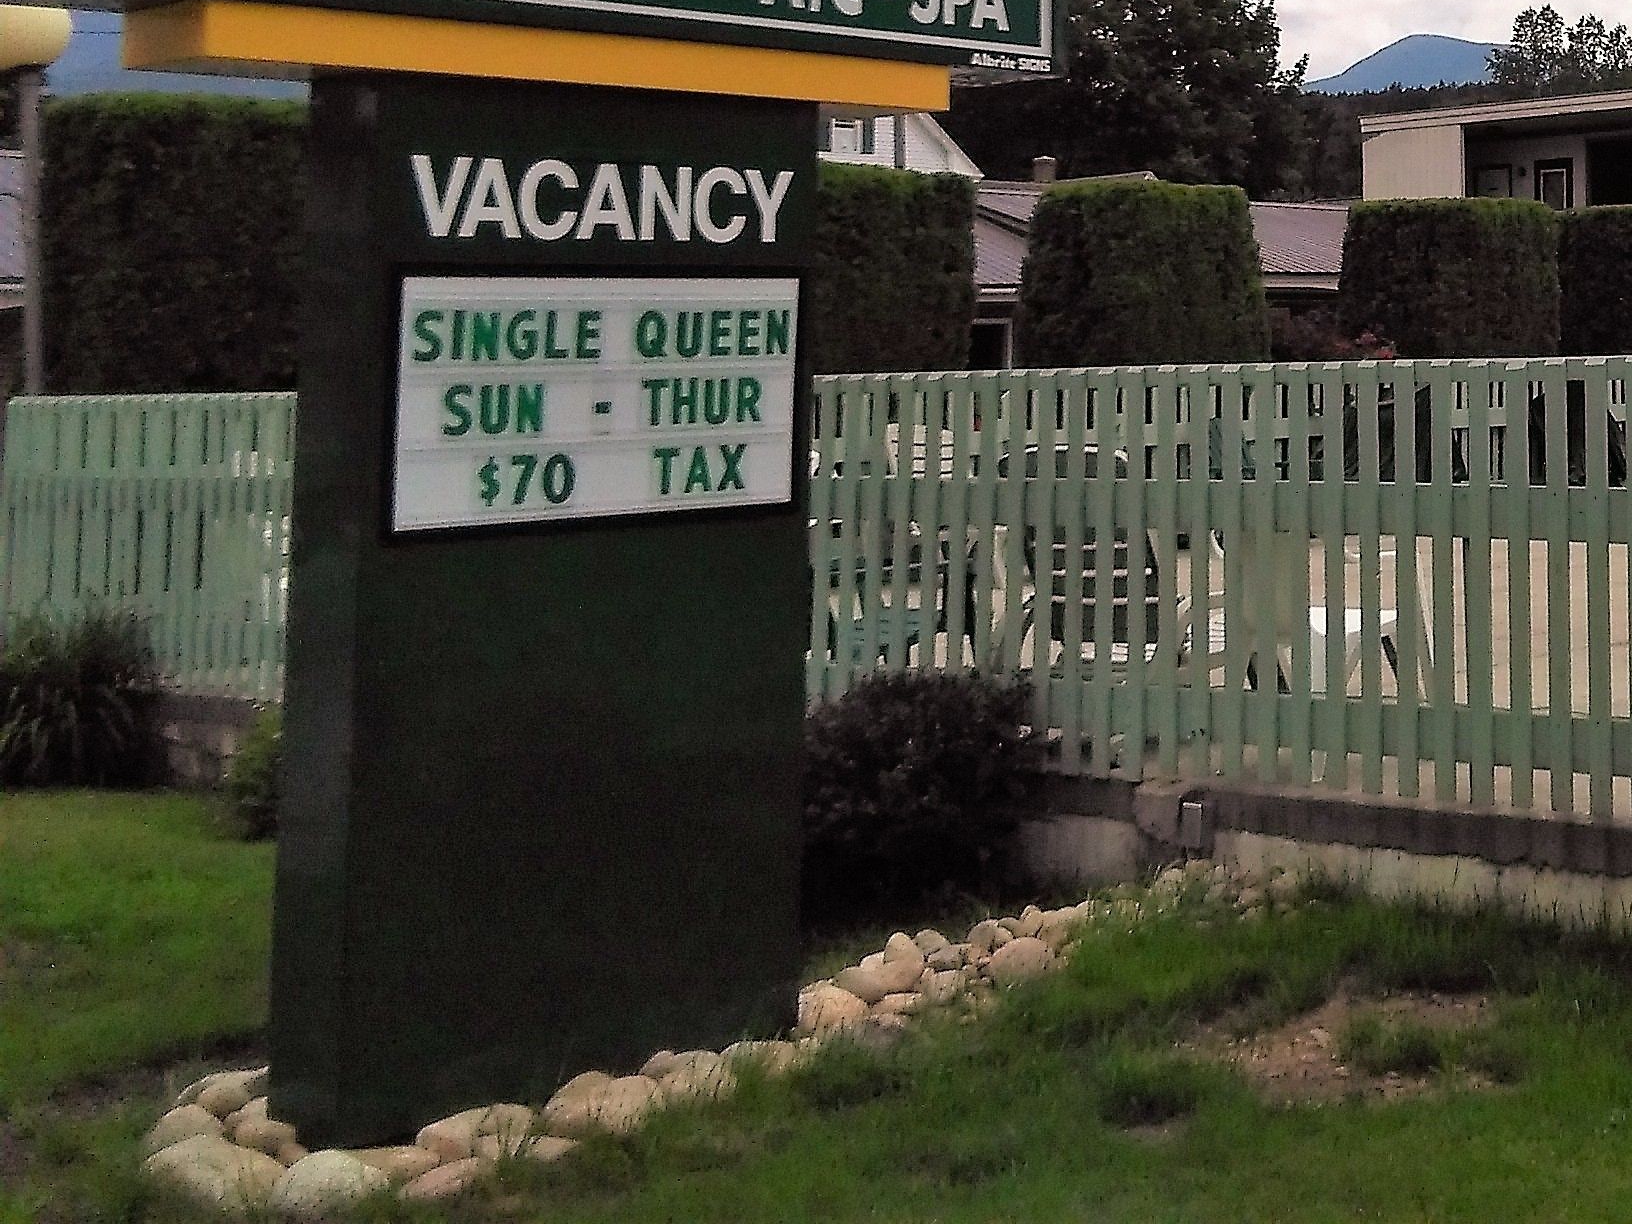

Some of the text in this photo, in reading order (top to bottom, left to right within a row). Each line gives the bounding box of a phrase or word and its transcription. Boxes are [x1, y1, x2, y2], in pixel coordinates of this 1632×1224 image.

[410, 153, 795, 243] VACANCY
[412, 308, 791, 362] SINGLE QUEEN
[441, 382, 545, 436] SUN
[641, 376, 763, 426] THUR
[477, 443, 748, 507] $70 TAX
